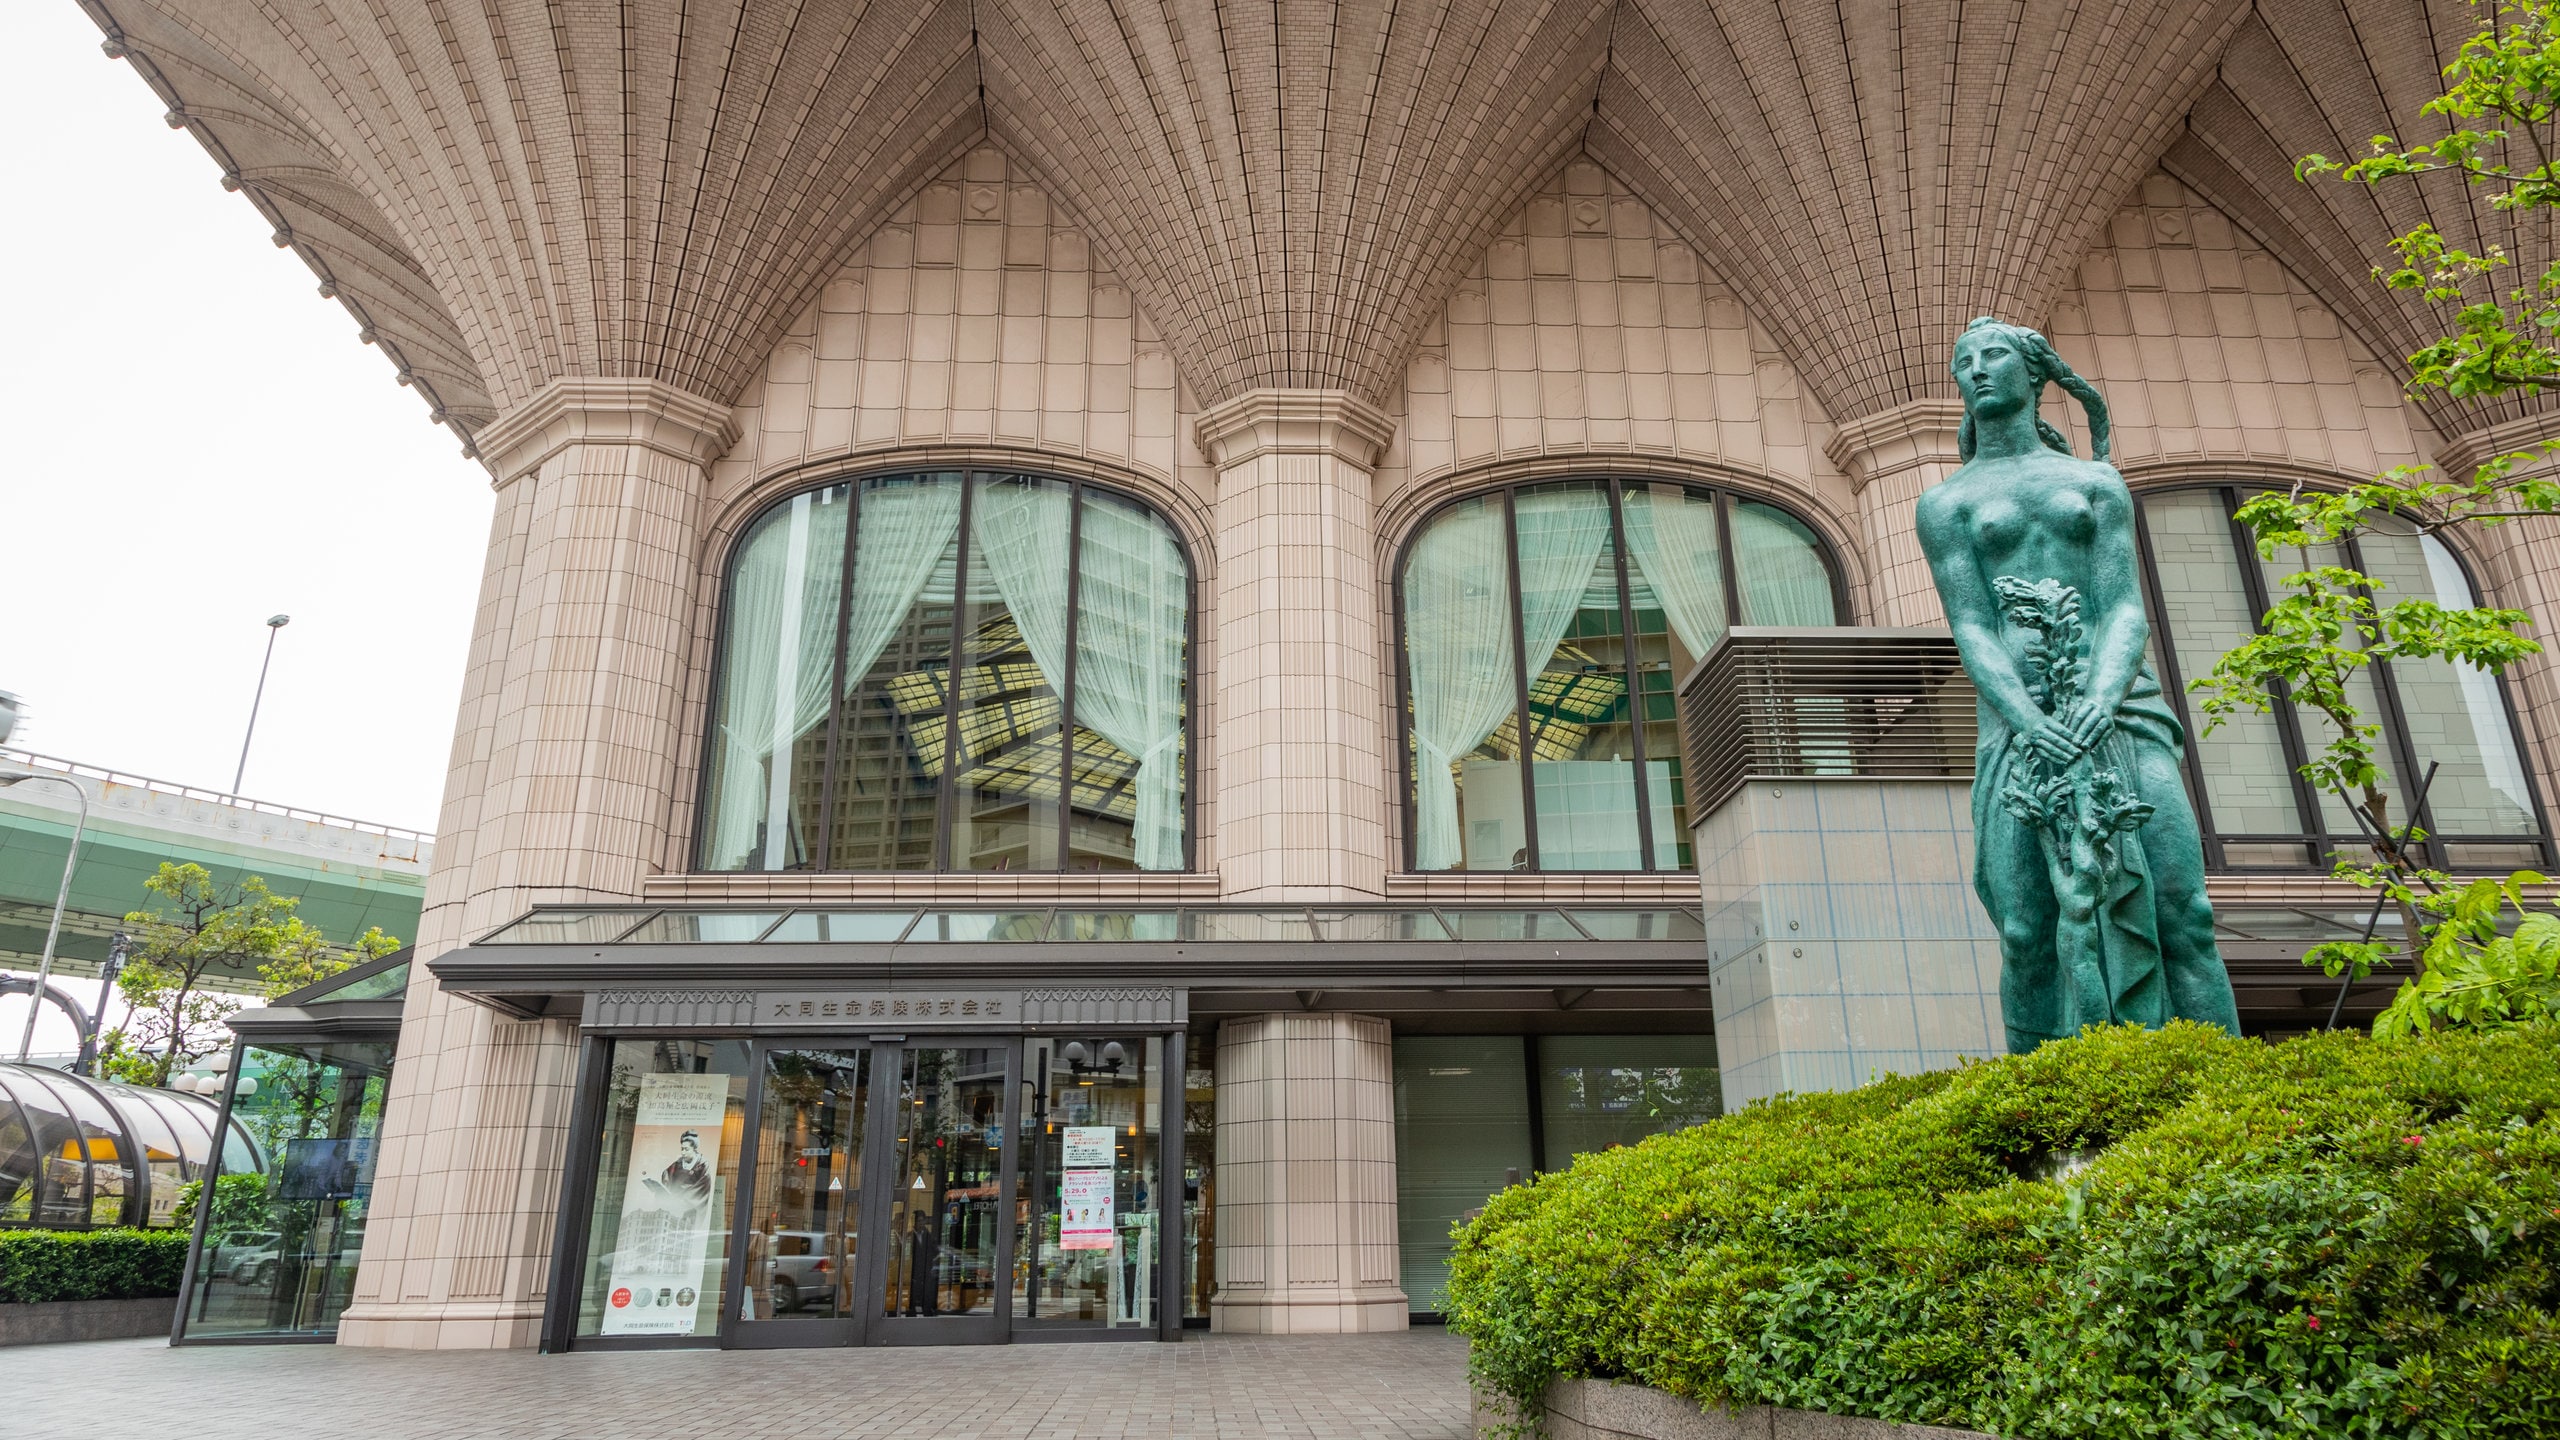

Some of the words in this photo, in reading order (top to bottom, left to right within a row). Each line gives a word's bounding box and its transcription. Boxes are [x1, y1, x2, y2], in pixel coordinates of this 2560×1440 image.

[774, 999, 1002, 1017] 大同生命保険株式会社
